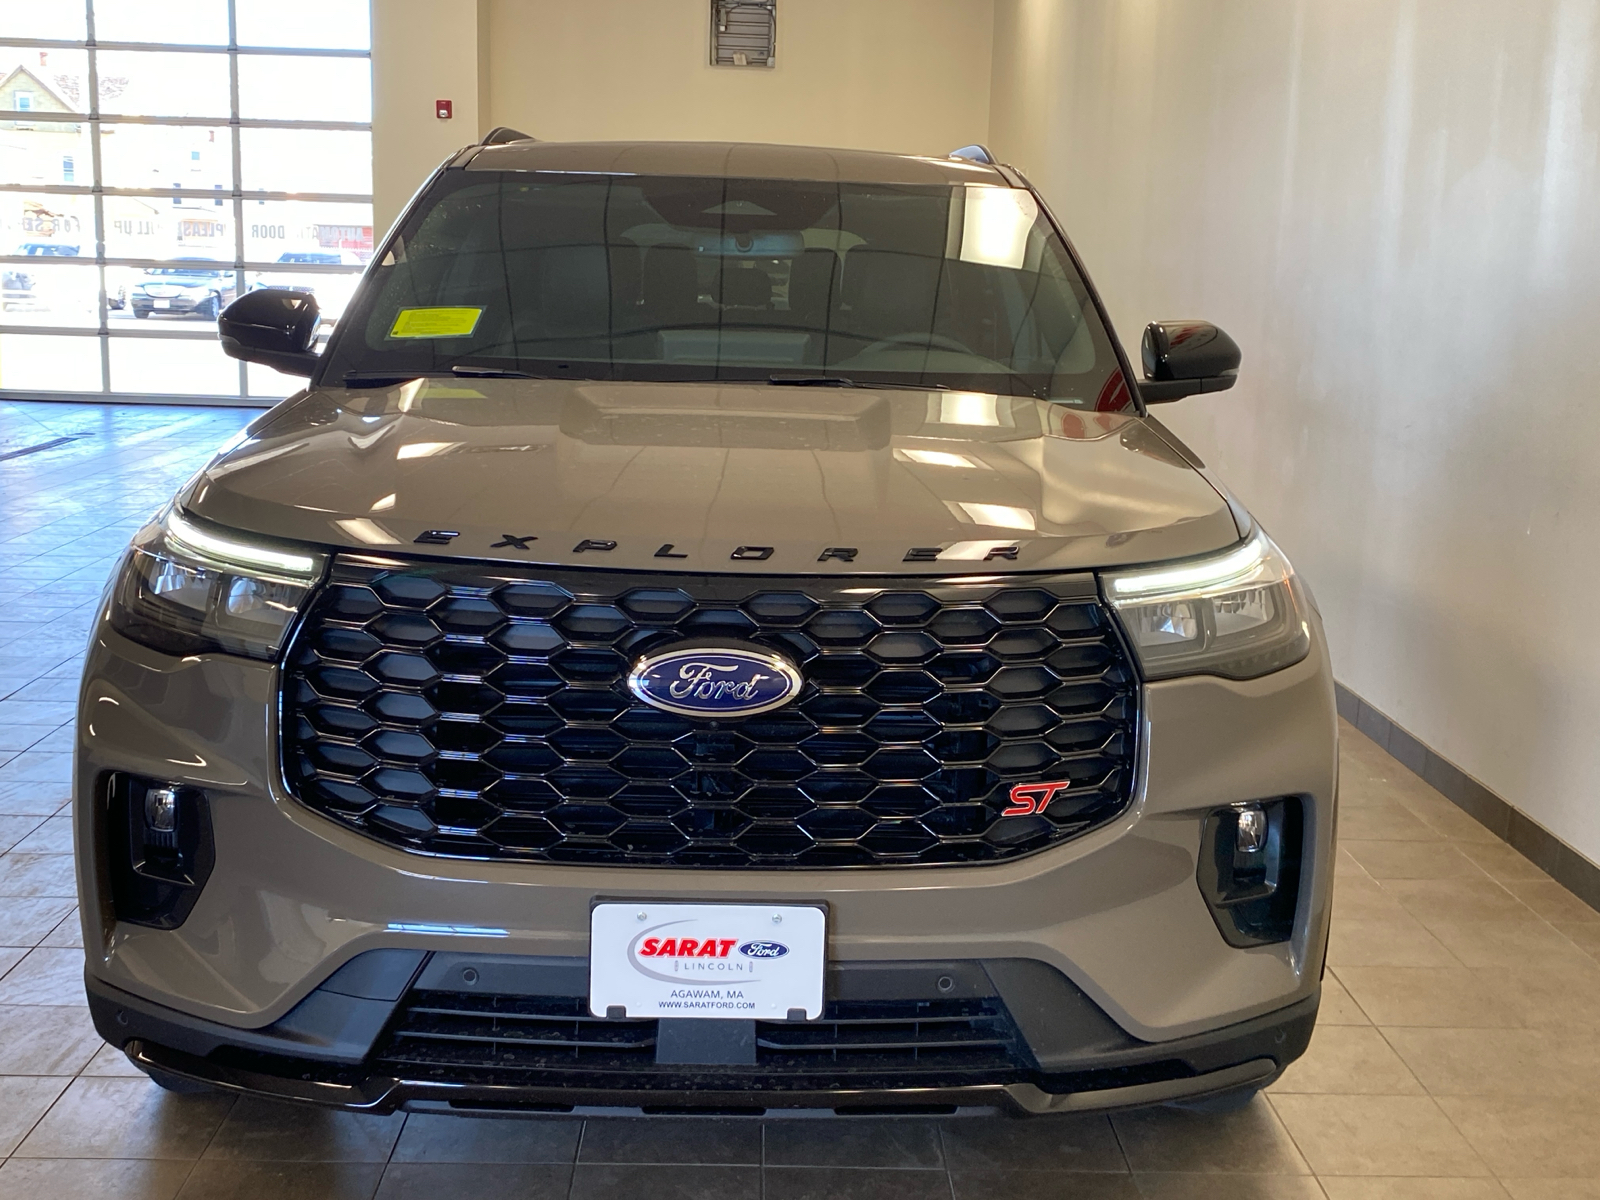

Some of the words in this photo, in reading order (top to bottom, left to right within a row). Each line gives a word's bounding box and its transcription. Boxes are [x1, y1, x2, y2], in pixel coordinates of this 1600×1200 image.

[413, 529, 1021, 562] EXPLORER
[669, 662, 759, 700] Ford
[1001, 780, 1071, 817] ST
[638, 936, 739, 959] SARAT
[747, 942, 780, 957] Ford
[684, 962, 743, 971] LINCOLN
[658, 1001, 756, 1010] WWW.SARATFORD.COM
[670, 989, 723, 999] AGAWAM,
[727, 990, 744, 999] MA
